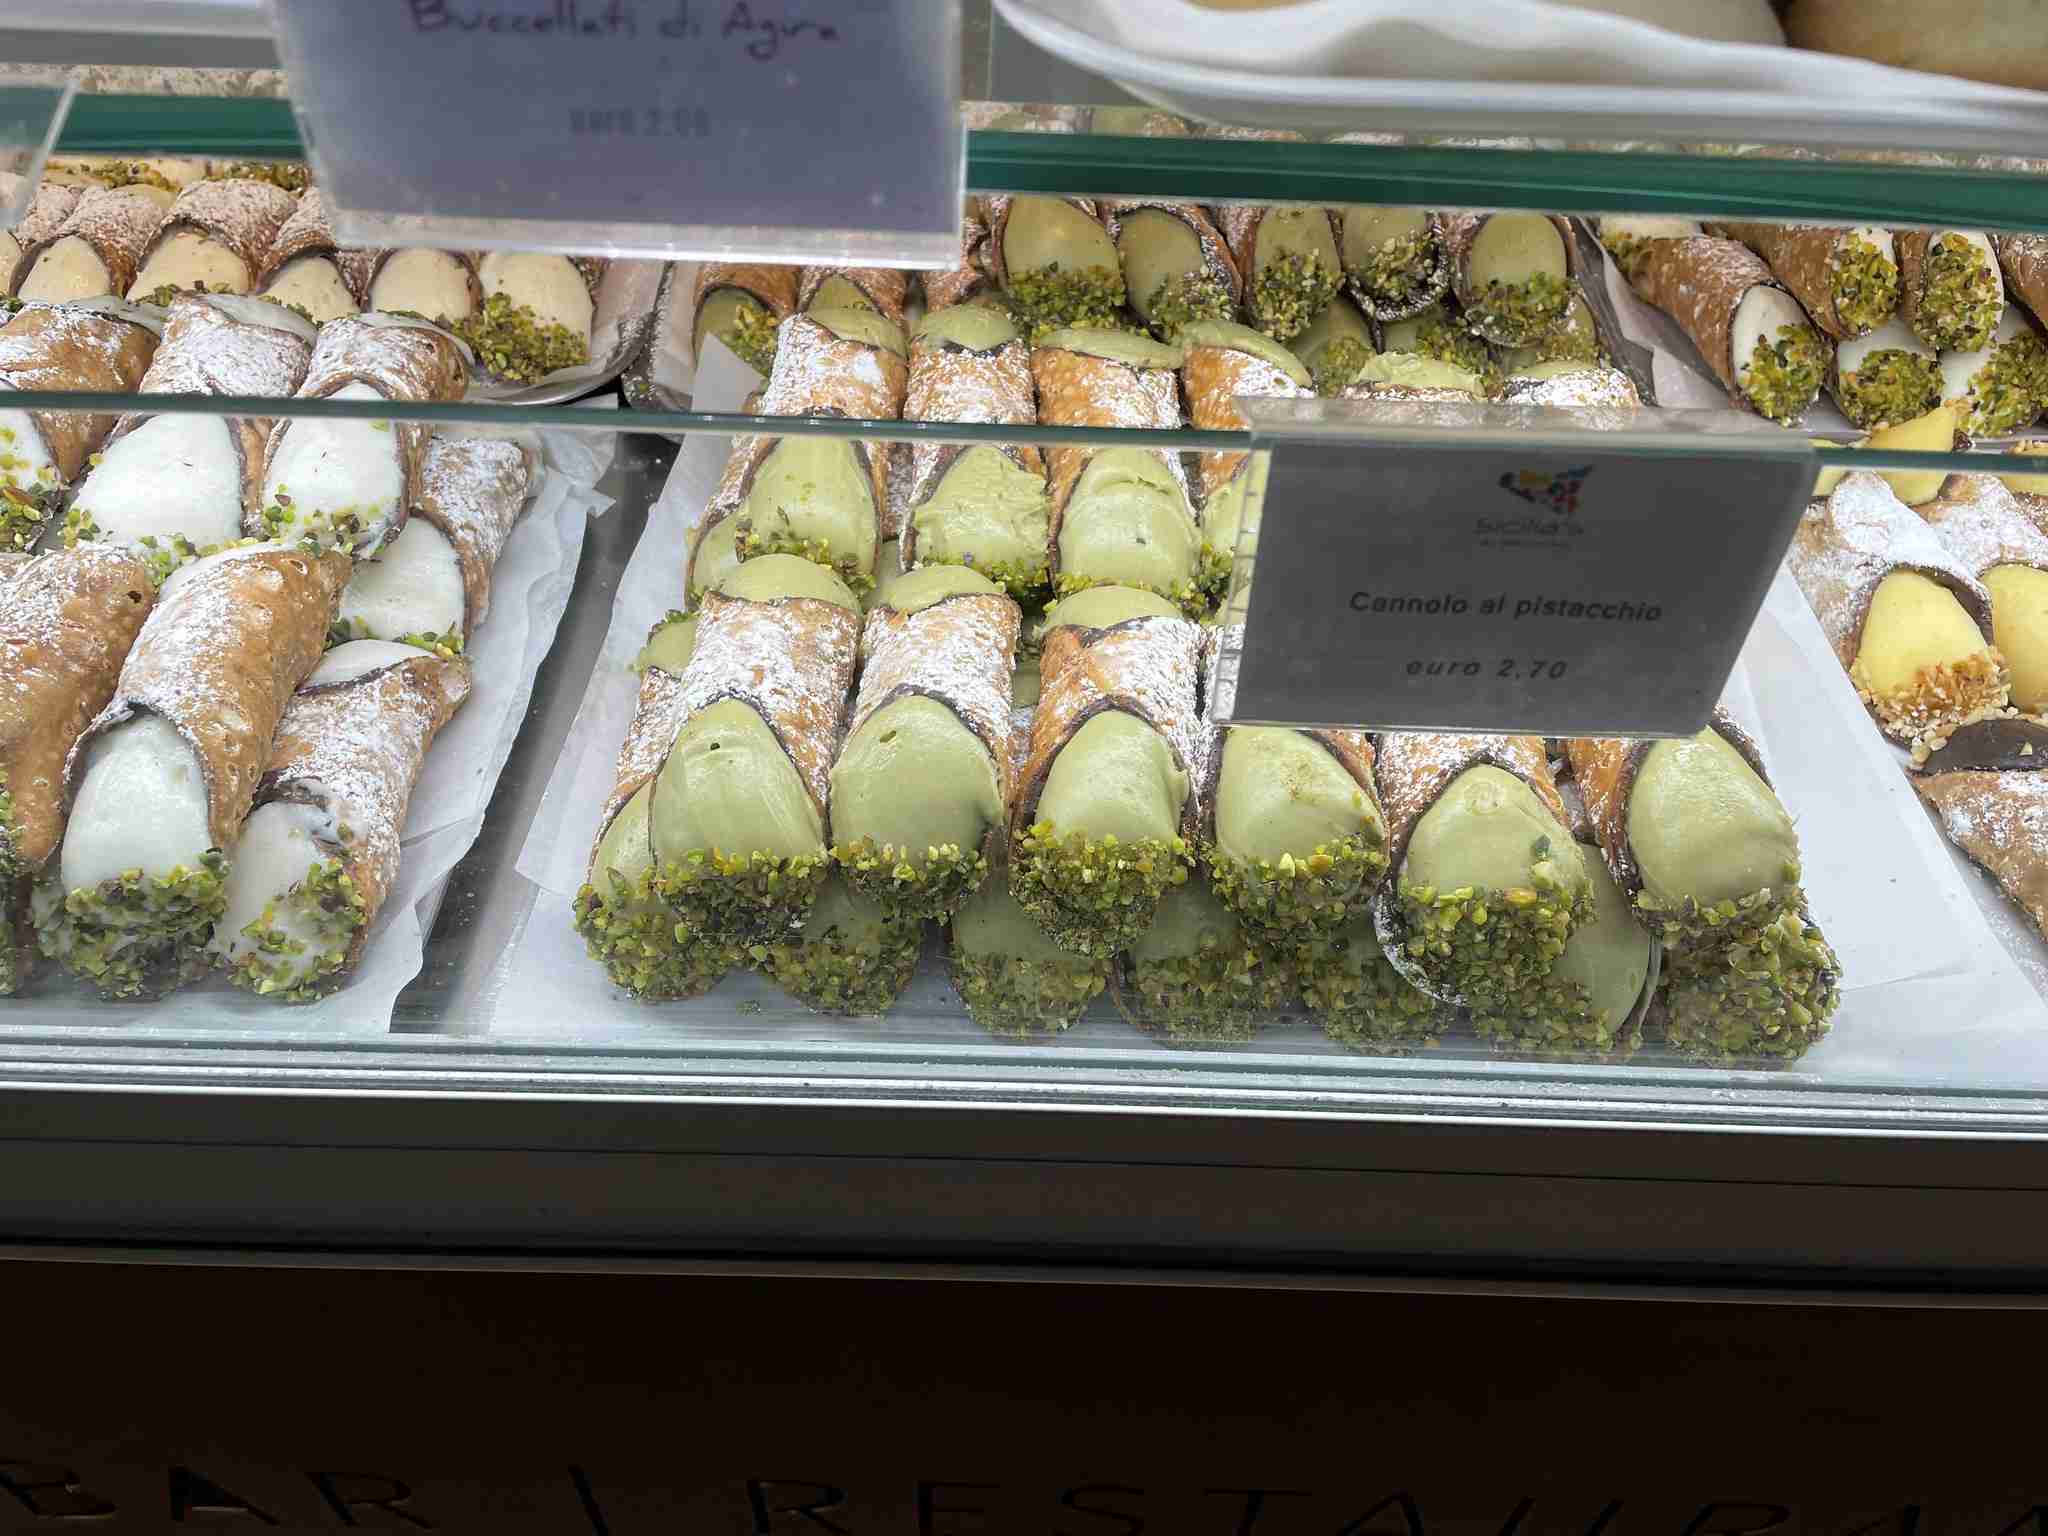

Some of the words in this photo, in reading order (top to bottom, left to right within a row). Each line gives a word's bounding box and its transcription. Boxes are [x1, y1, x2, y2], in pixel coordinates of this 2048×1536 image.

[405, 0, 638, 39] Buccellati
[658, 0, 702, 39] di
[1349, 590, 1468, 616] Cannolo
[1480, 591, 1506, 616] al
[1513, 593, 1664, 623] pistacchio
[1405, 659, 1482, 677] euro
[0, 1460, 433, 1529] BAR
